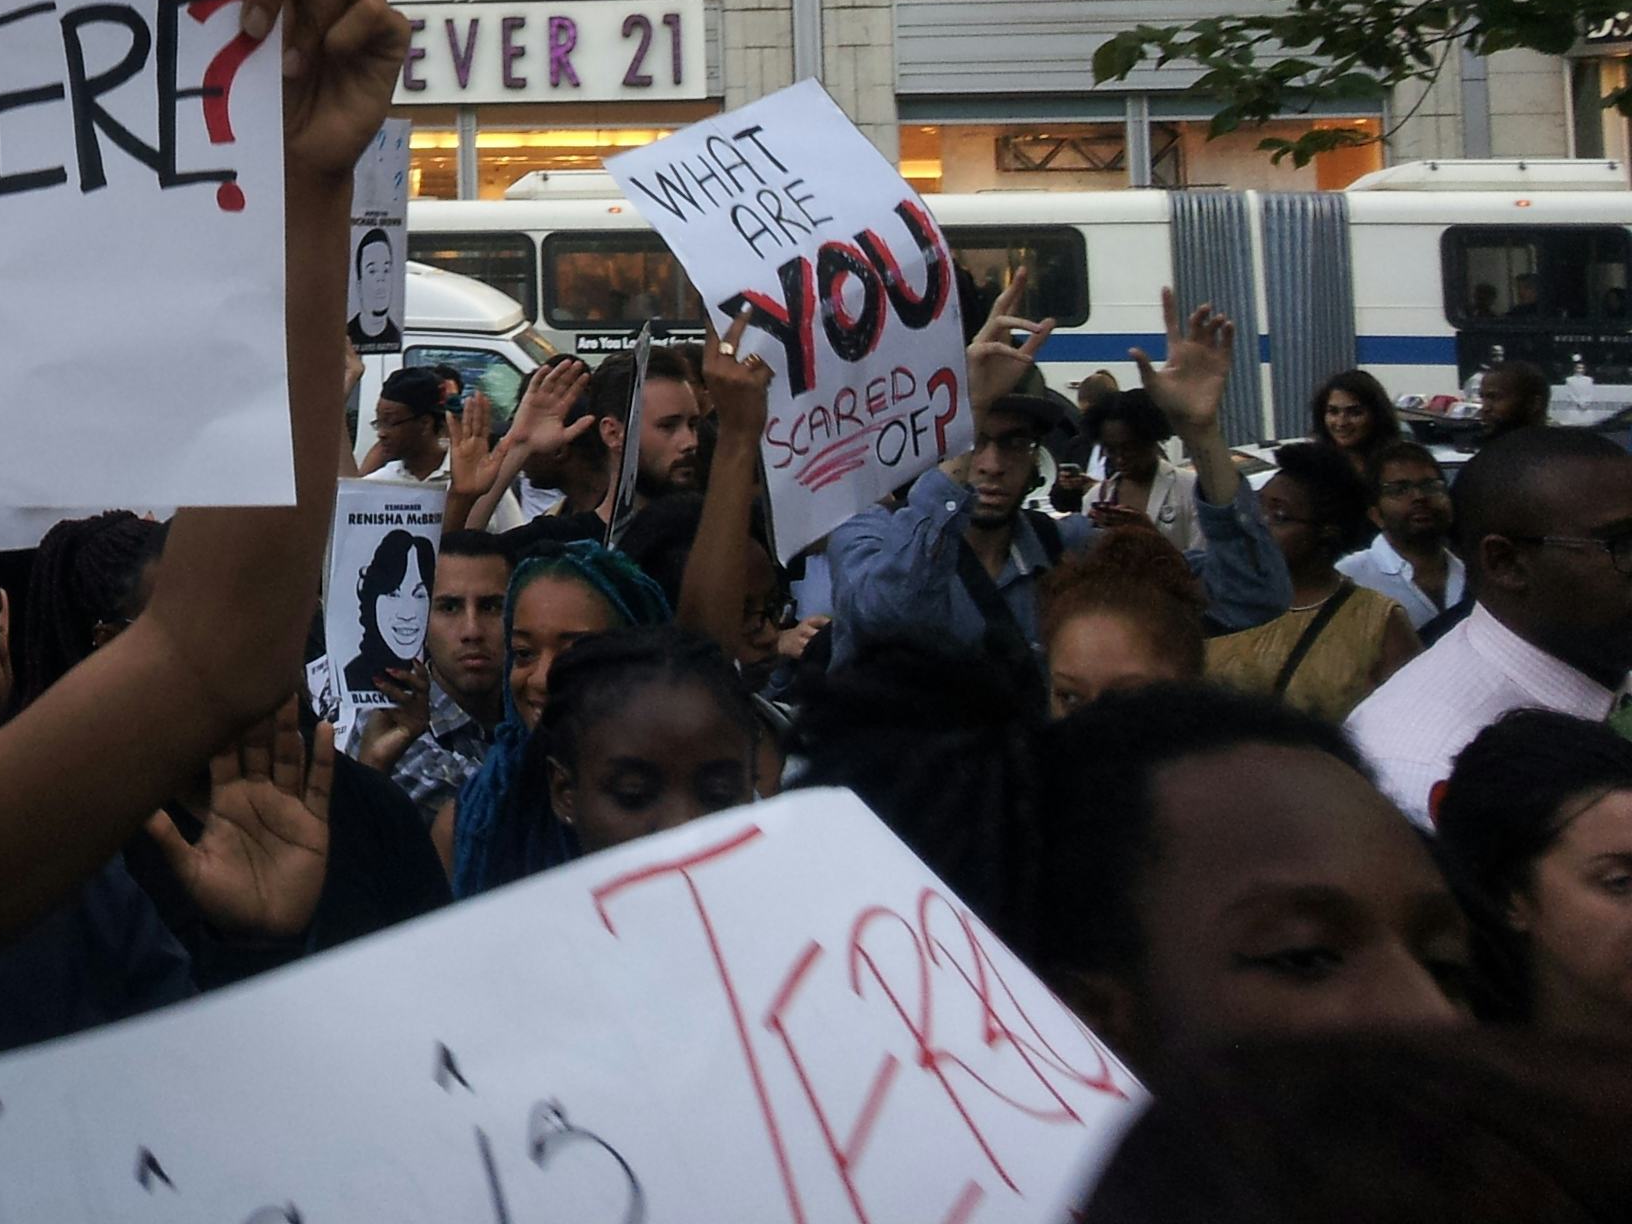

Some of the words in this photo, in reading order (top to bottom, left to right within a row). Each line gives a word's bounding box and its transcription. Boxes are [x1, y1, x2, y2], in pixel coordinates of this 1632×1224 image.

[621, 13, 683, 88] 21
[630, 125, 789, 223] WHAT
[730, 178, 834, 260] ARE
[599, 337, 622, 349] You
[718, 199, 952, 399] YOU
[767, 366, 917, 469] SCARED
[876, 367, 959, 466] OF?
[348, 512, 404, 526] RENISHA
